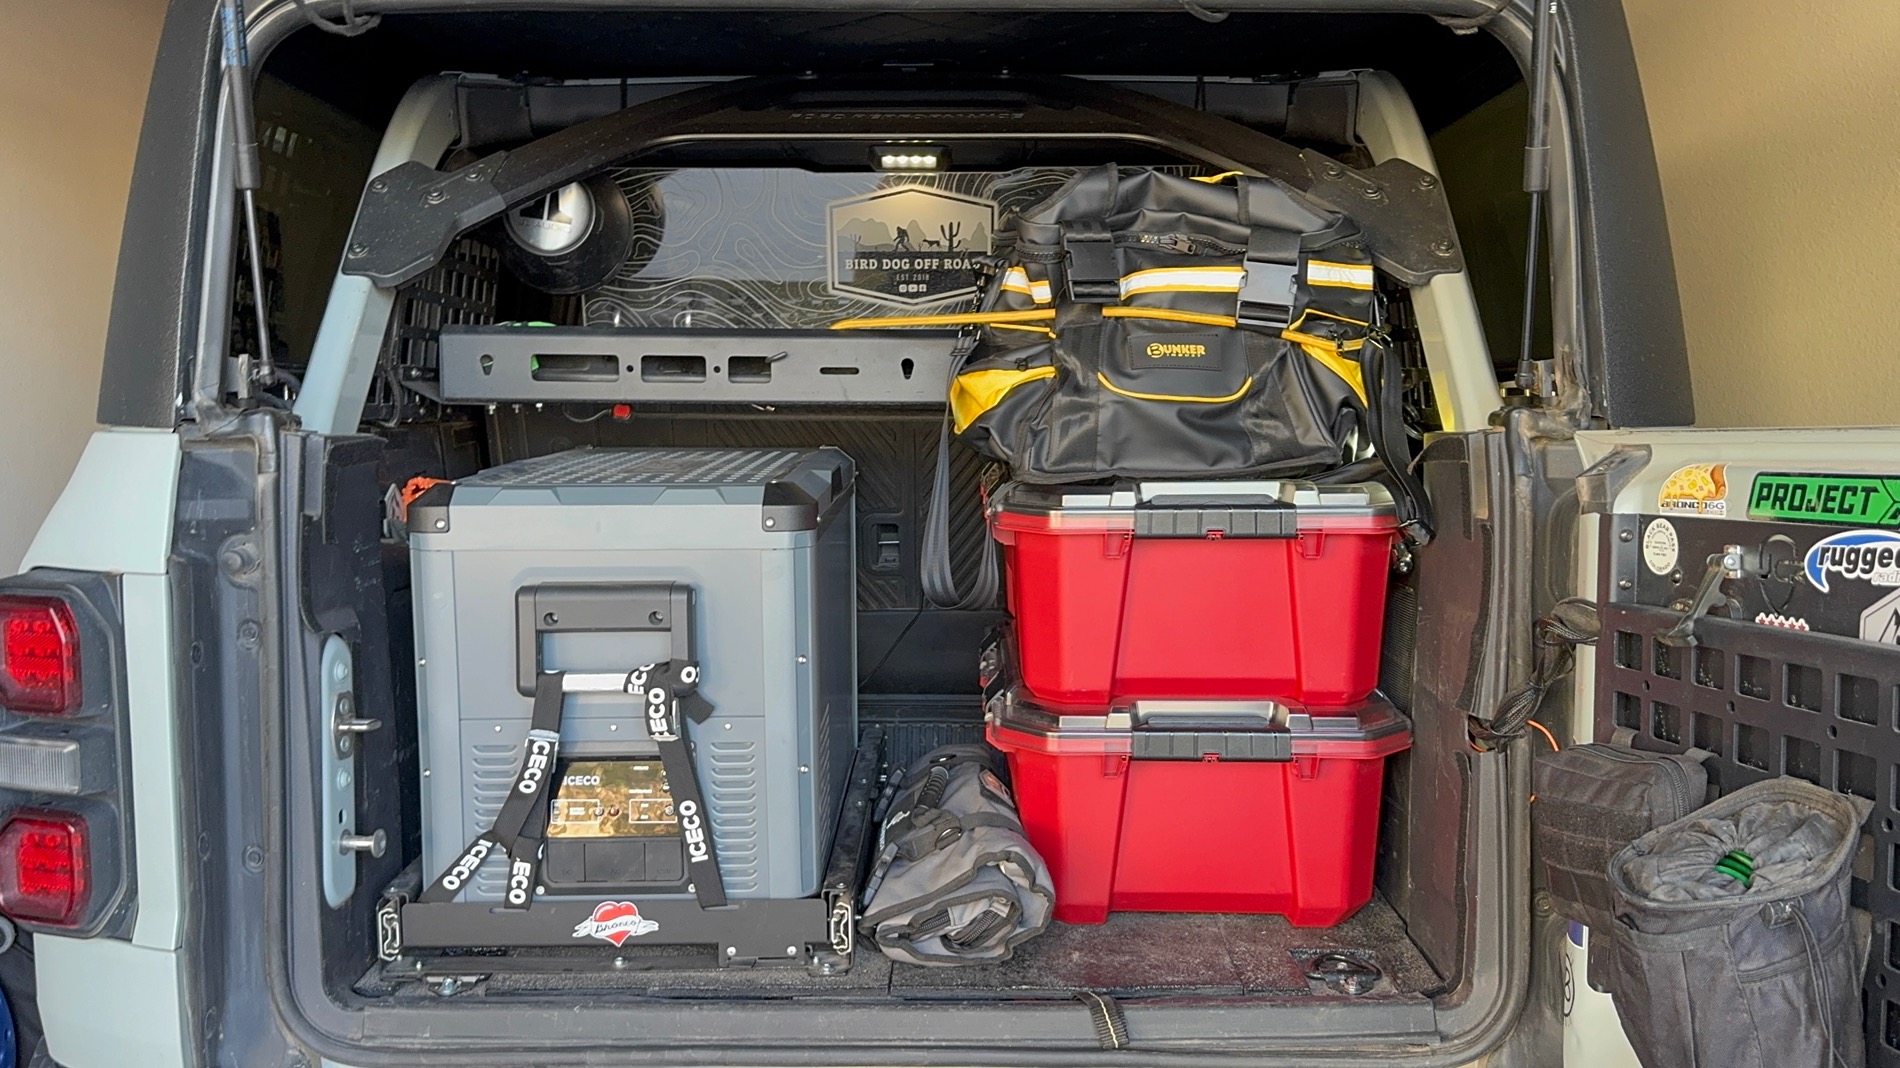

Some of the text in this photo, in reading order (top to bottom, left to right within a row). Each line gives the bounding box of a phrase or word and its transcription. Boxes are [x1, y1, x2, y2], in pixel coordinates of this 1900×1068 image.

[845, 258, 878, 270] BIRD
[882, 258, 910, 270] DOG
[914, 258, 939, 270] OFF
[896, 273, 909, 281] EST
[1146, 342, 1206, 358] BUNKER
[1754, 482, 1881, 516] PROJECT
[648, 687, 669, 736] ECO
[518, 740, 551, 794] CECO
[563, 775, 600, 786] ICECO
[679, 799, 709, 863] ICECO
[442, 838, 493, 890] ICECO
[594, 919, 637, 936] Bronco
